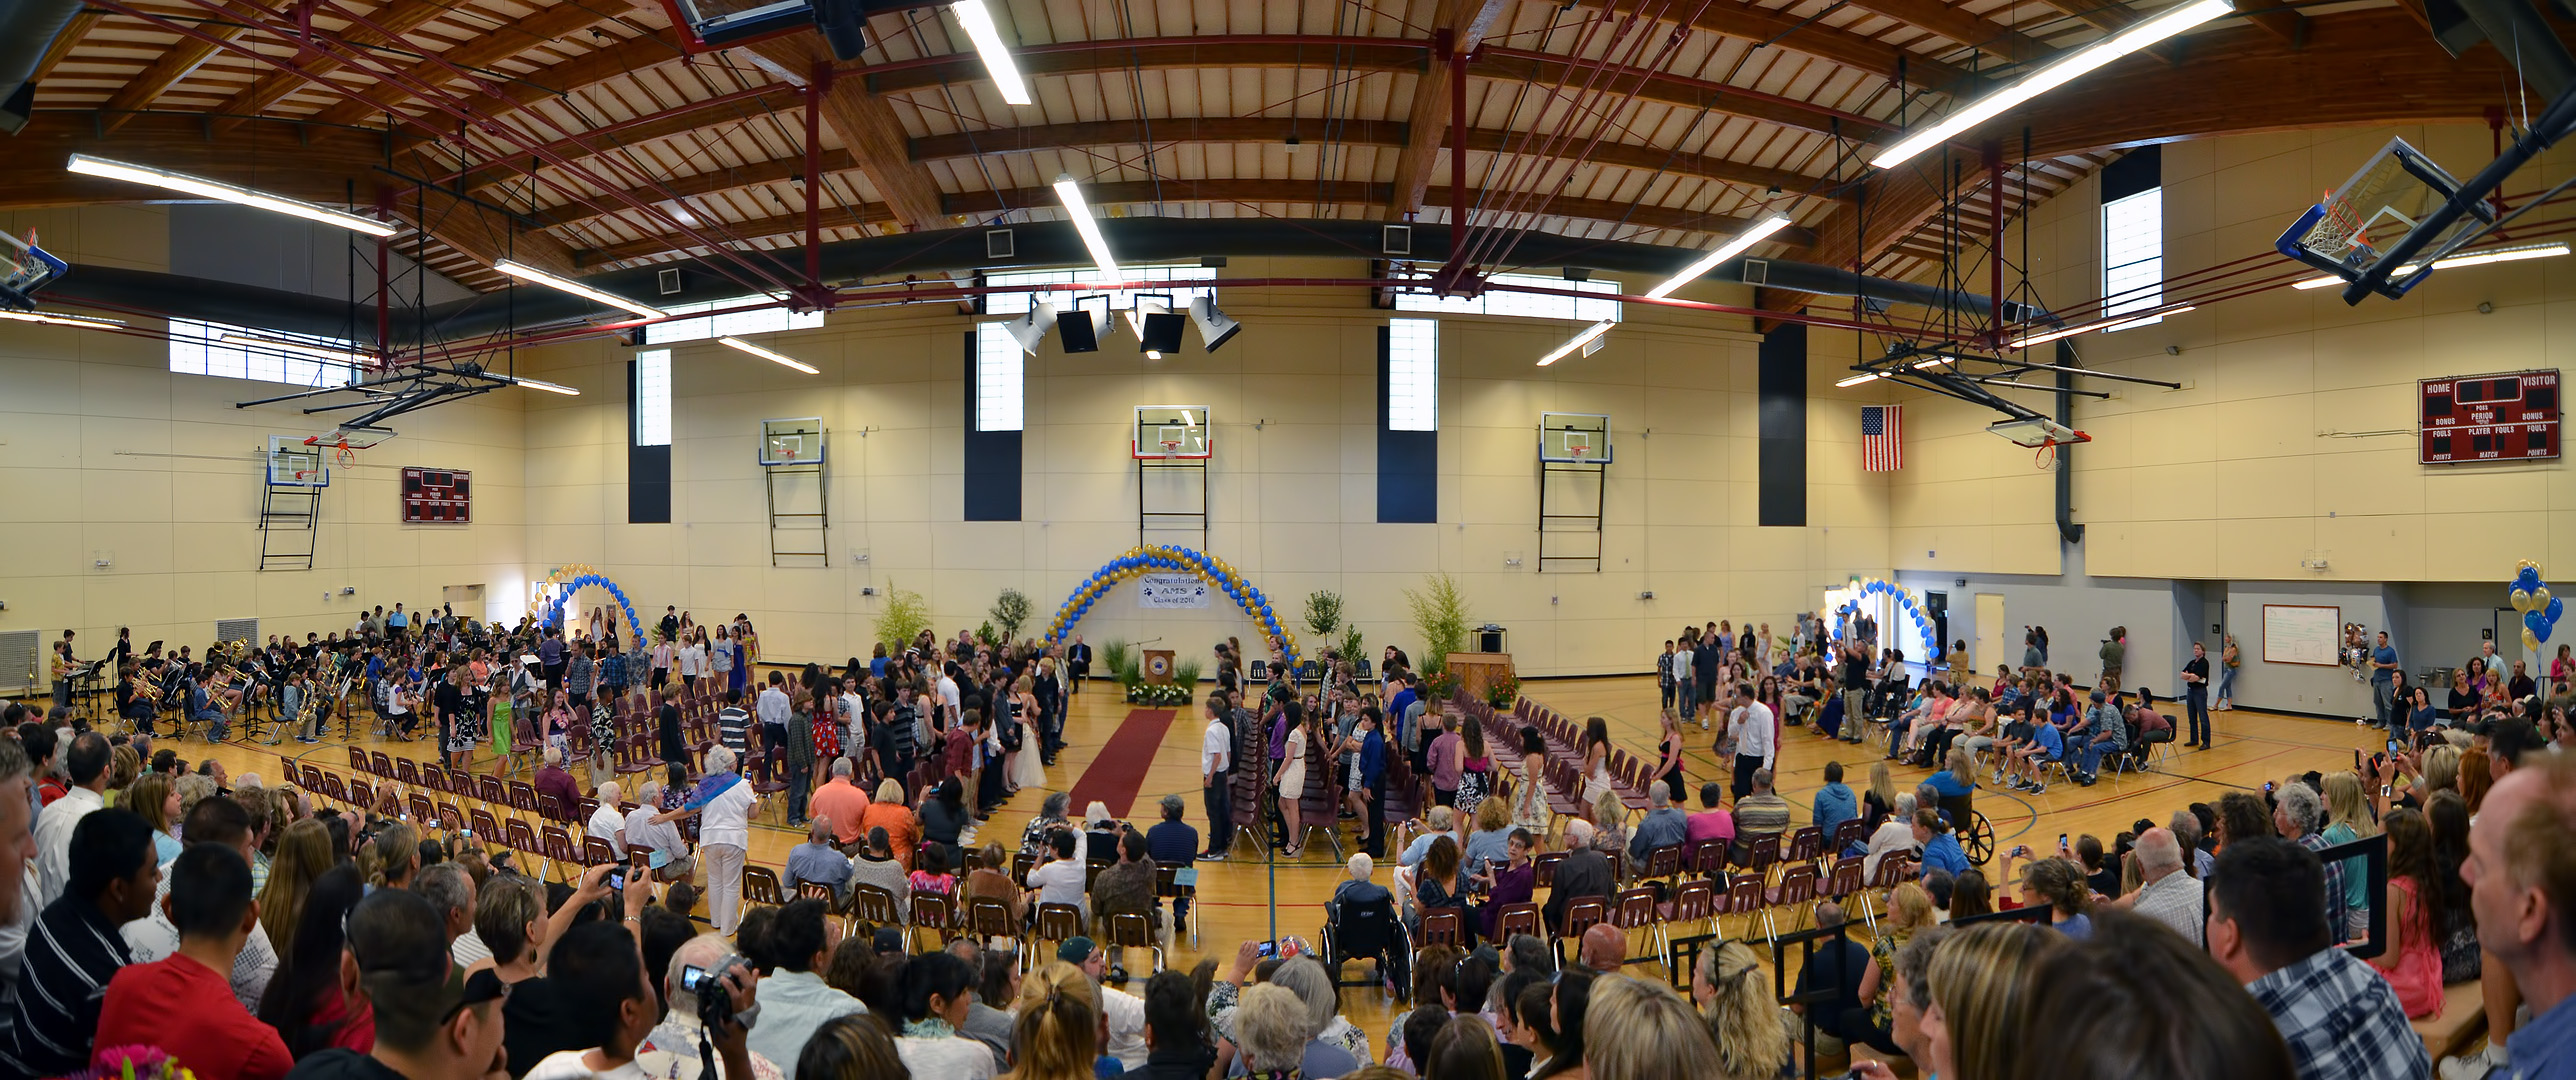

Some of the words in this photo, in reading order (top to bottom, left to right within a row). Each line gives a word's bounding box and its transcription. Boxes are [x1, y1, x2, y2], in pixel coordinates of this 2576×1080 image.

[2523, 376, 2556, 386] VISITOR
[2427, 384, 2450, 394] HOME
[2471, 412, 2493, 420] PERIOD
[2522, 412, 2543, 420] BONUS
[2436, 418, 2455, 426] BONUS
[2496, 426, 2514, 434] FOULS
[1144, 576, 1204, 585] Congratulations
